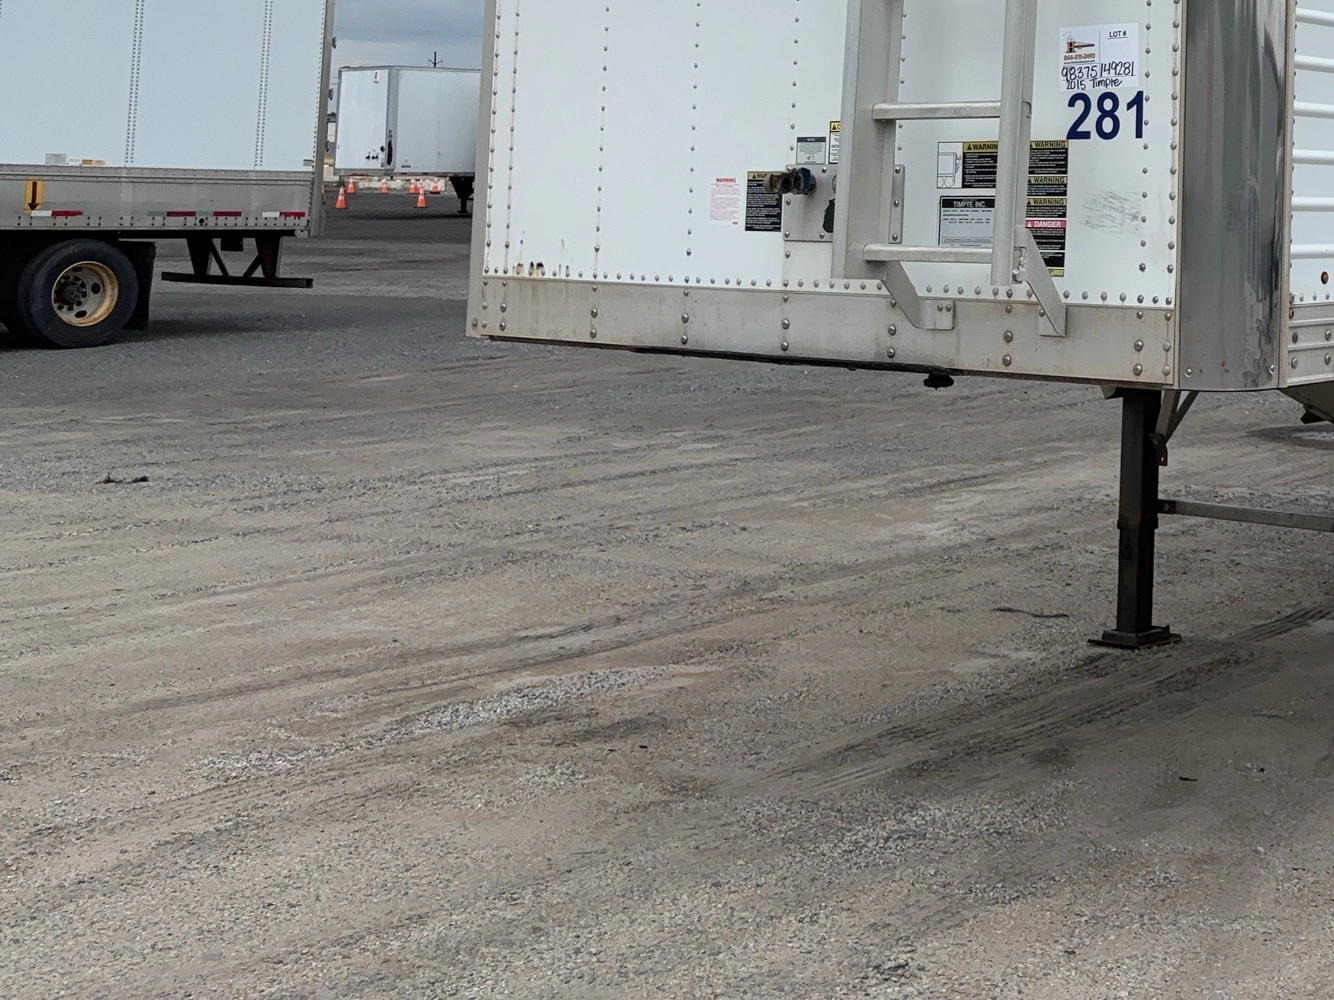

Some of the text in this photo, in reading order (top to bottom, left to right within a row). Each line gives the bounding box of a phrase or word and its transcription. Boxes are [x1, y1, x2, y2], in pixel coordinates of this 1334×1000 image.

[1109, 30, 1122, 38] LOT
[1061, 65, 1098, 80] 98375
[1066, 77, 1123, 91] 2015 Timpte
[1066, 90, 1144, 140] 281
[1034, 220, 1062, 228] DANGER
